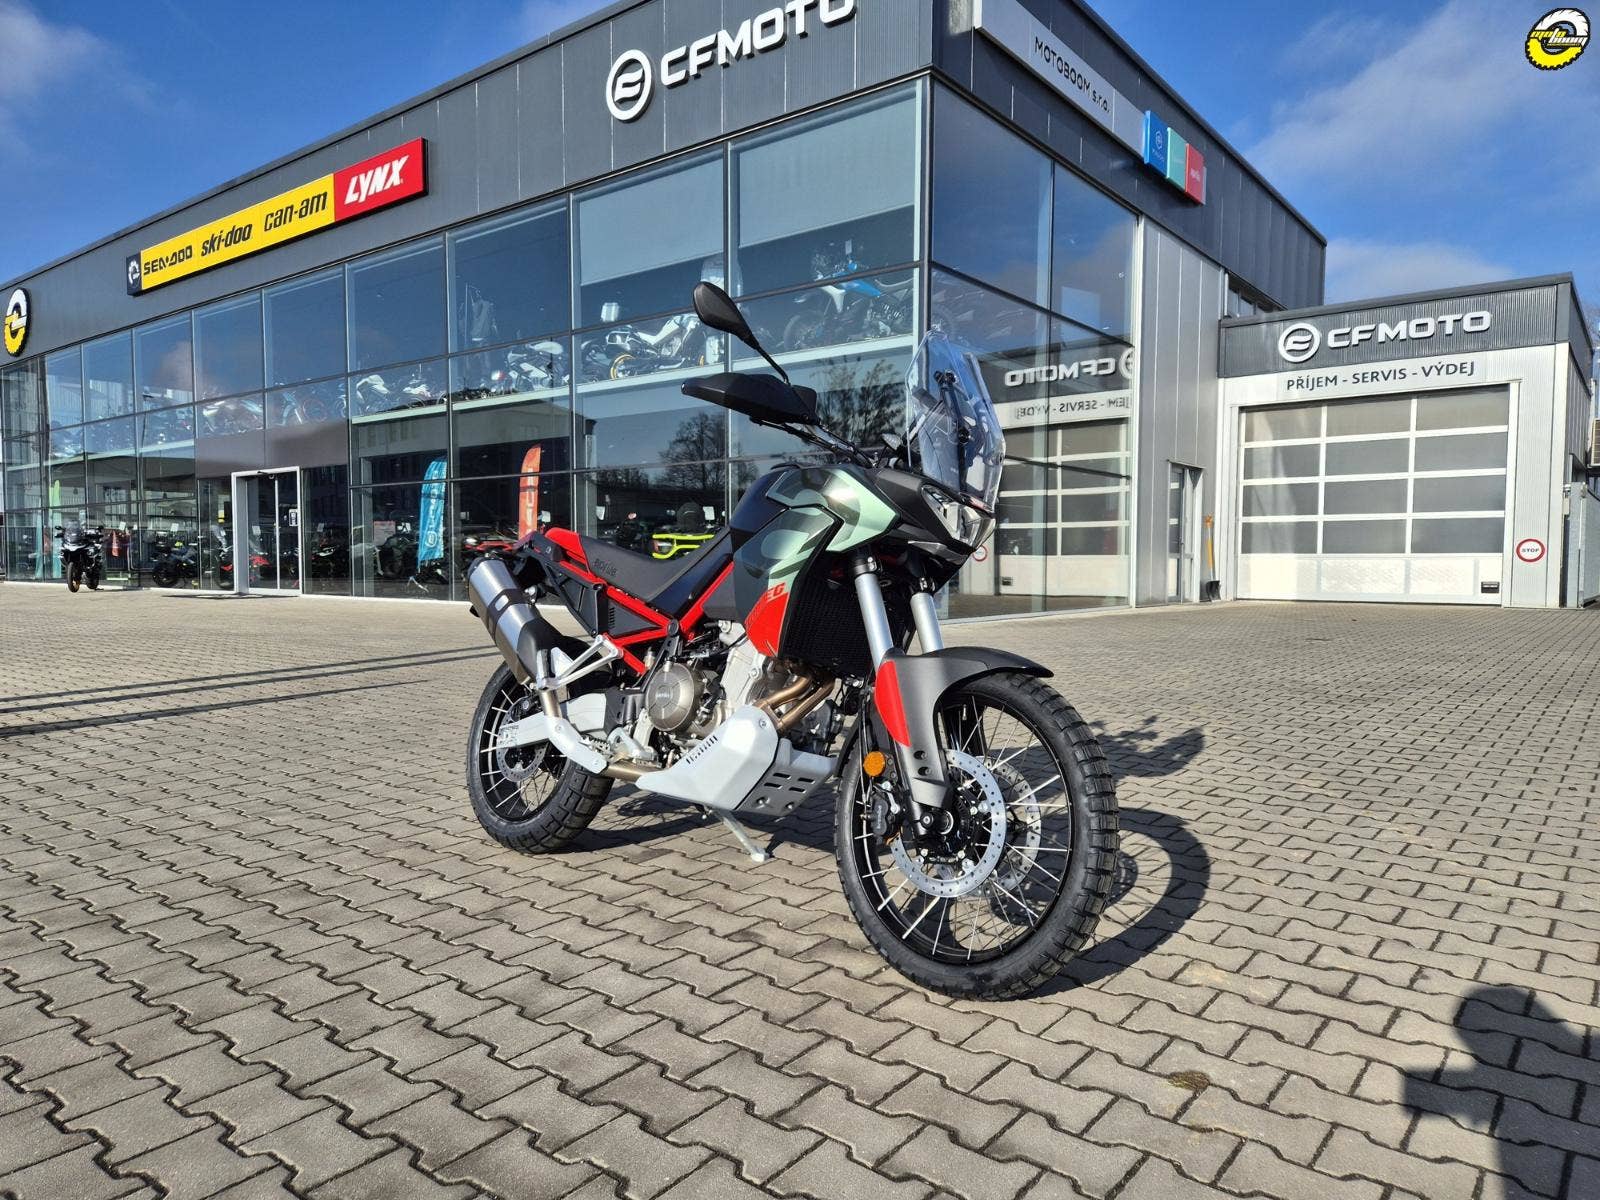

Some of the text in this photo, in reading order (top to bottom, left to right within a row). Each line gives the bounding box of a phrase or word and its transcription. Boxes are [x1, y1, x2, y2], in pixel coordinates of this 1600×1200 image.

[660, 0, 855, 86] CFMOTO
[1034, 36, 1091, 96] MOTOBOOM
[344, 155, 409, 205] LYNX
[263, 191, 328, 232] can-am
[200, 223, 252, 257] ski-doo
[1327, 311, 1491, 348] CFMOTO
[1287, 375, 1338, 391] PŘÍJEM
[1352, 368, 1407, 385] SERVIS
[1421, 361, 1475, 378] VÝDEJ
